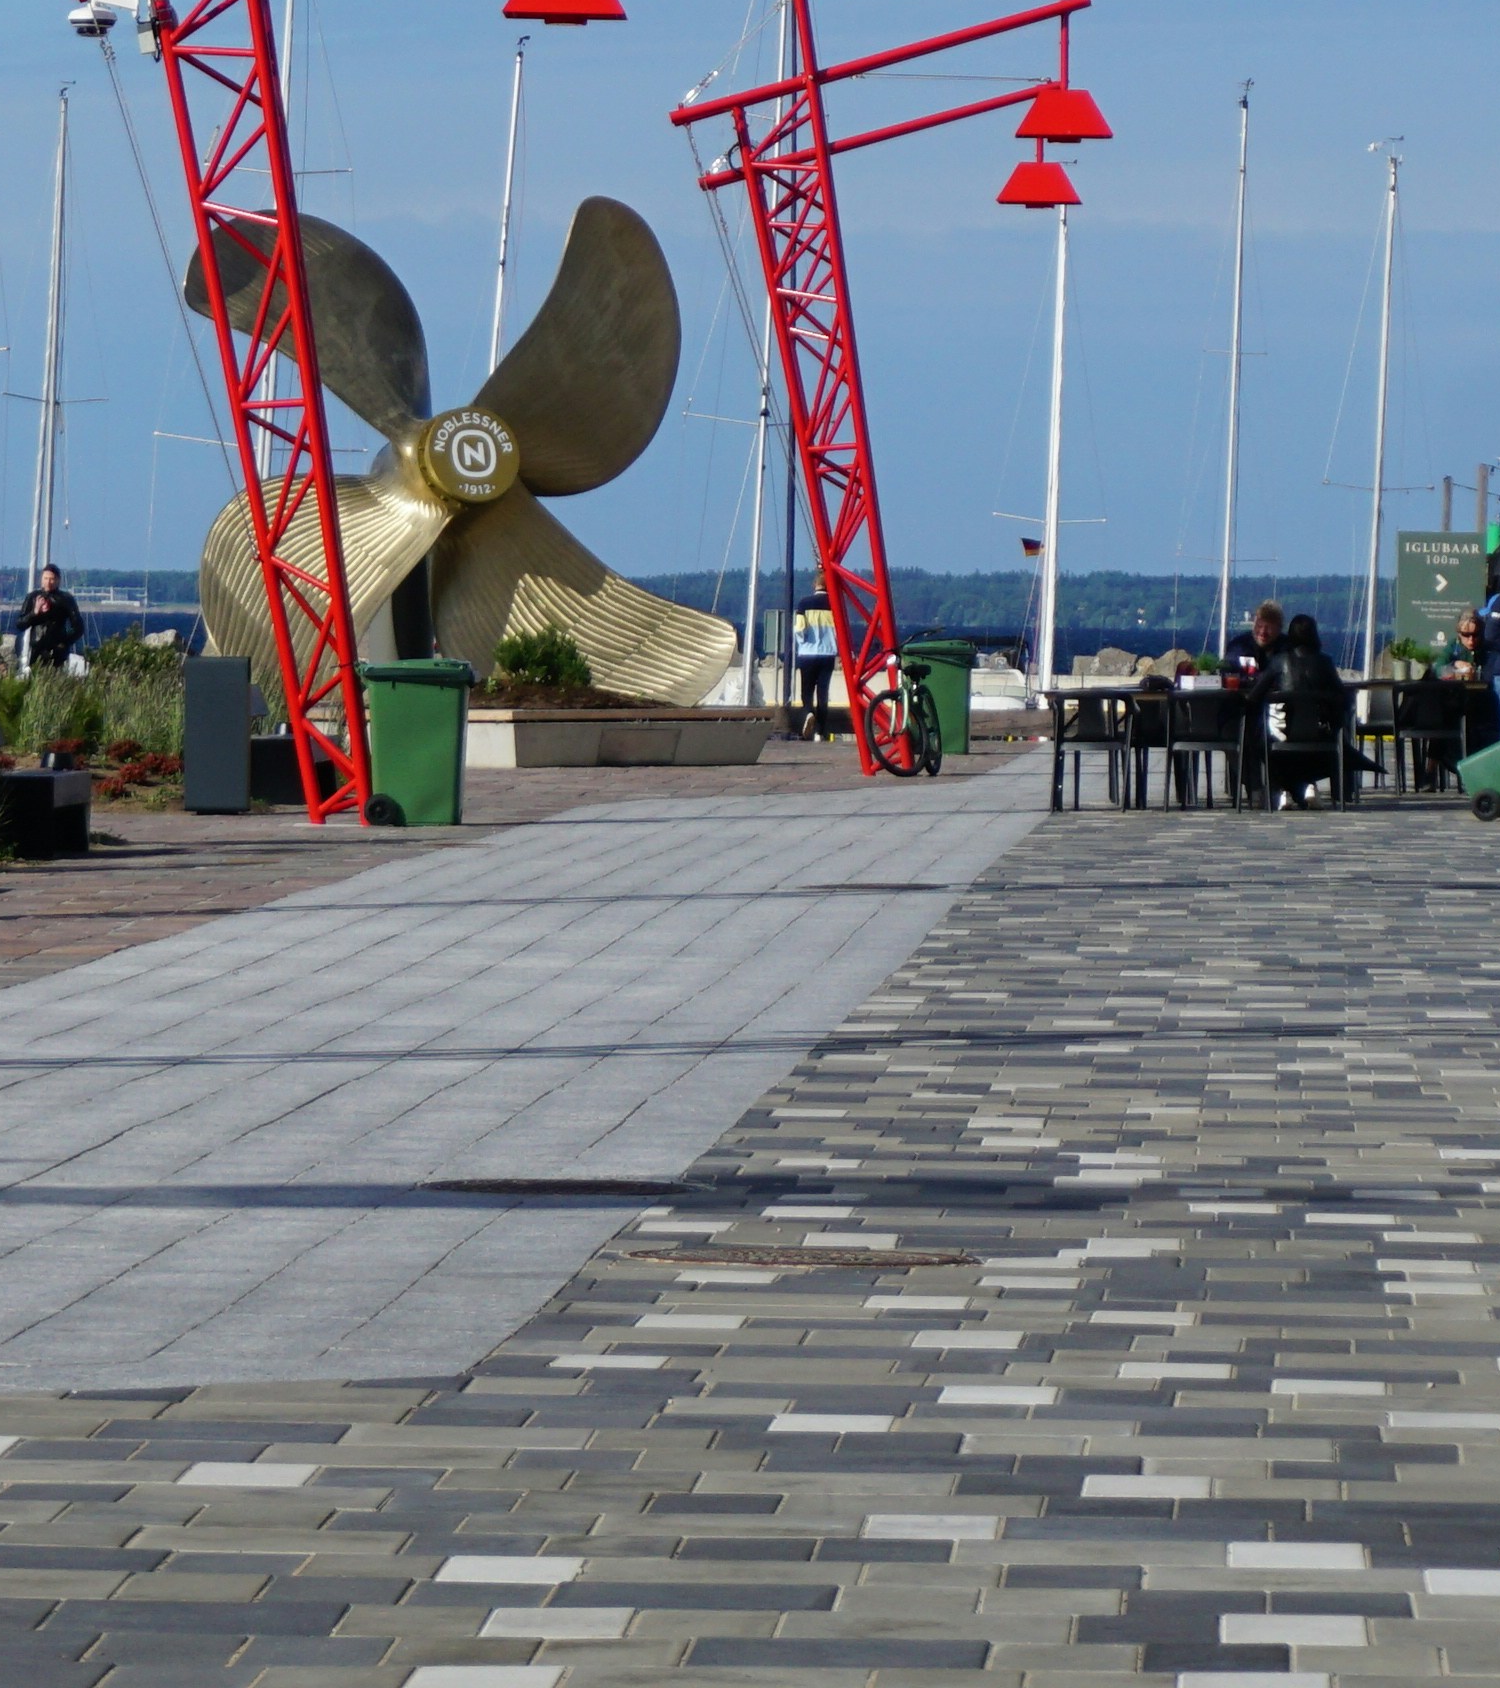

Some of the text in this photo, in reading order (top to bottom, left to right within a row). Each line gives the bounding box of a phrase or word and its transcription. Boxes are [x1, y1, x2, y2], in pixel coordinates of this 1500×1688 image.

[433, 412, 513, 453] NOBLESSNER
[463, 441, 486, 466] N
[464, 483, 492, 494] 1912
[1405, 542, 1480, 554] IGLUBAAR
[1426, 555, 1459, 565] 100m
